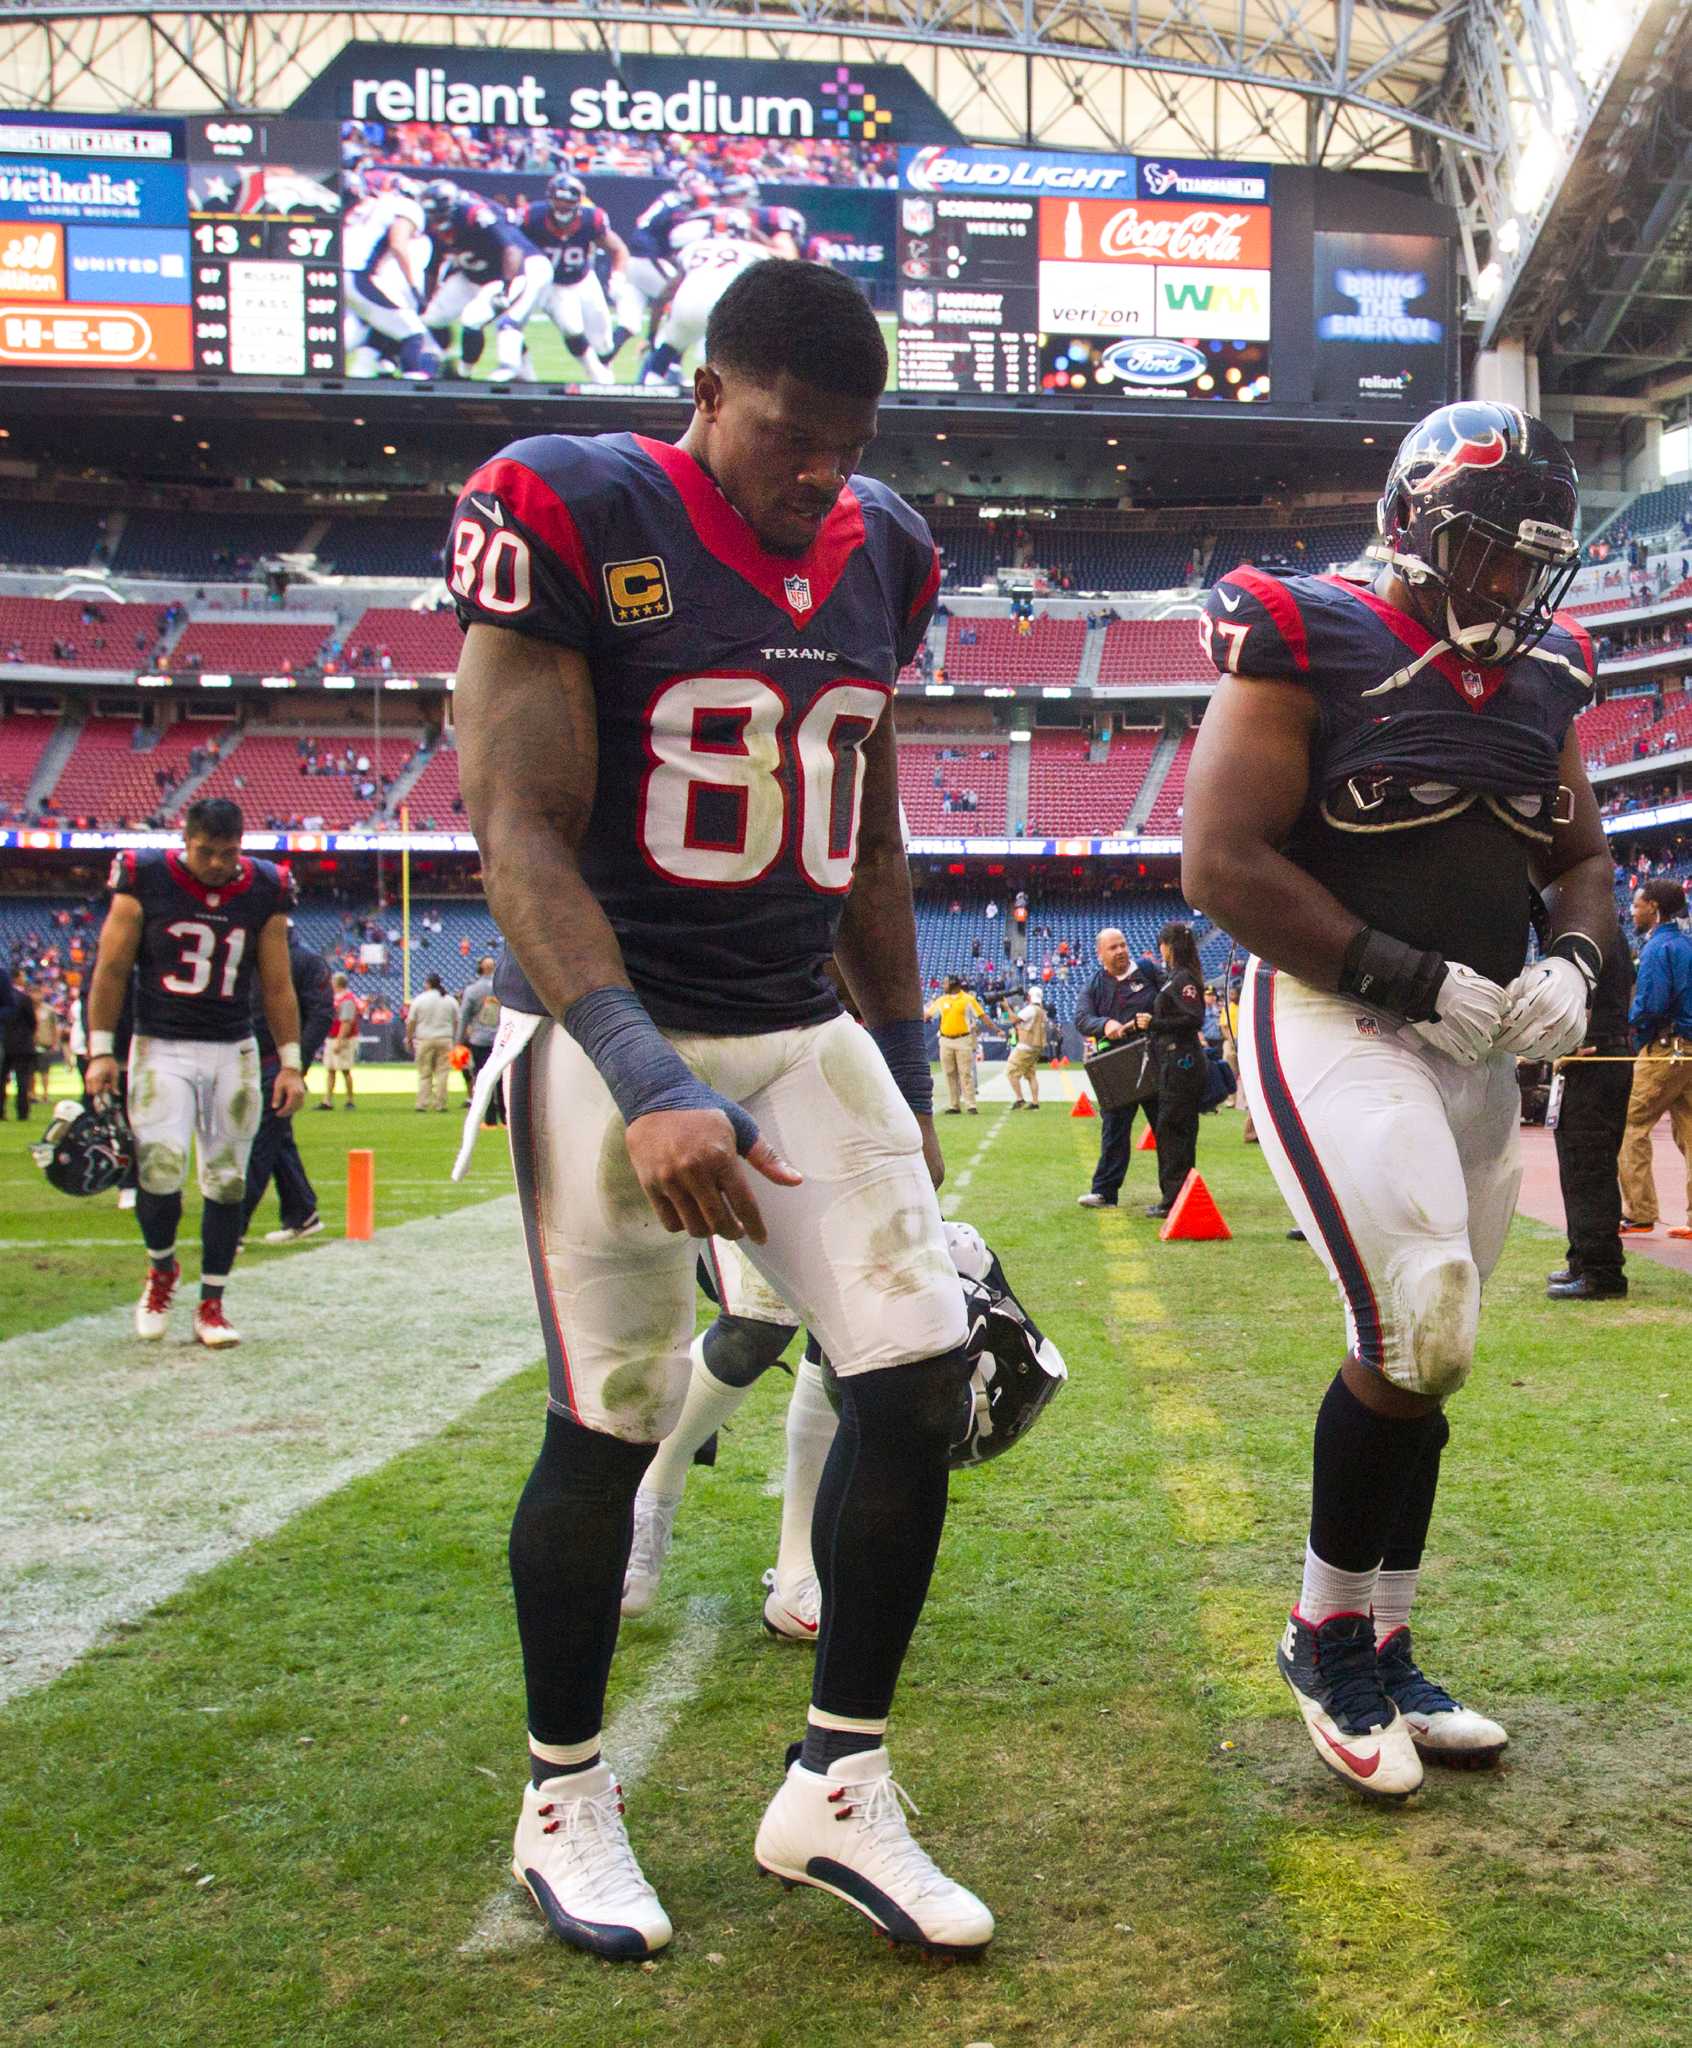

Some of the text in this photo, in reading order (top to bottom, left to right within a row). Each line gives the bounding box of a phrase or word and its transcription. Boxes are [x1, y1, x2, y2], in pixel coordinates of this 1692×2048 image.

[352, 67, 814, 137] reliant stadium
[194, 225, 334, 256] 13 37
[72, 256, 159, 274] UNITED
[1052, 303, 1140, 328] verizon
[1359, 299, 1406, 317] THE
[1126, 349, 1184, 374] Ford
[1358, 375, 1406, 390] reliant
[609, 562, 665, 608] C
[760, 648, 838, 662] TEXANS
[637, 668, 891, 896] 80
[162, 919, 248, 1001] 31
